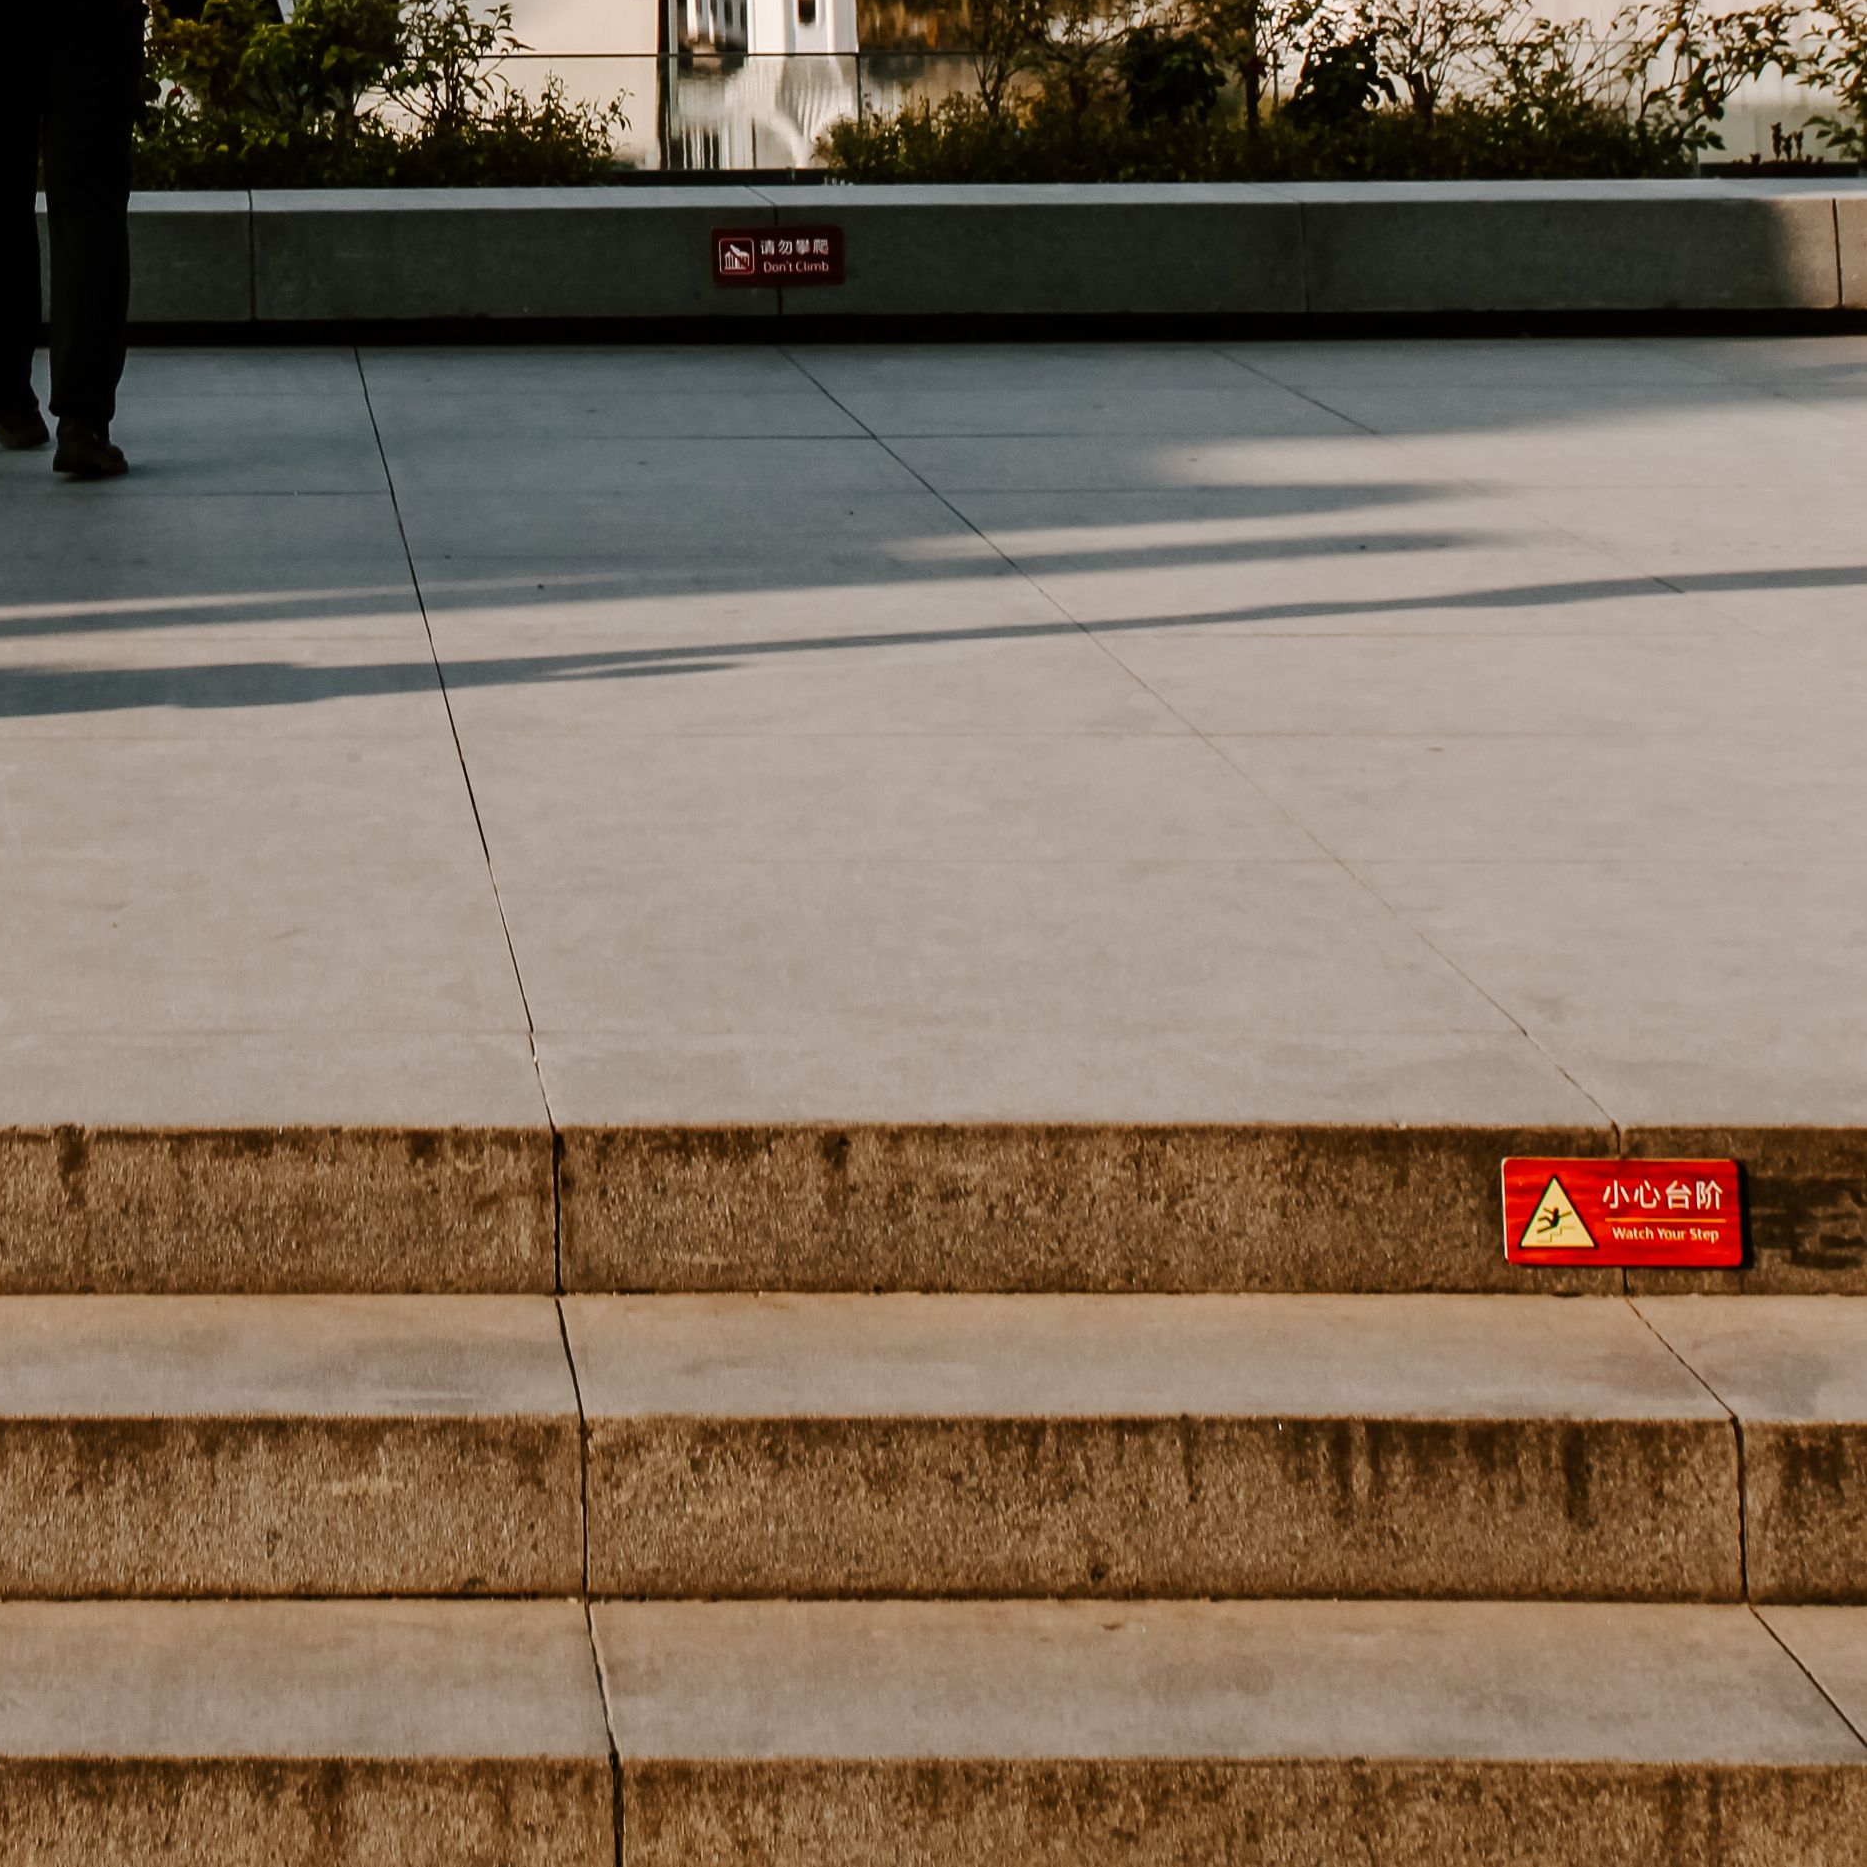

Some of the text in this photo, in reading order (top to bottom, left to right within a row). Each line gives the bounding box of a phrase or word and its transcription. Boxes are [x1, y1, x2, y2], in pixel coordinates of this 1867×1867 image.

[761, 239, 829, 255] 请勿攀爬
[764, 261, 829, 273] Don't Climb
[1602, 1179, 1724, 1210] 小心台阶
[1612, 1226, 1720, 1244] Watch Your Step
